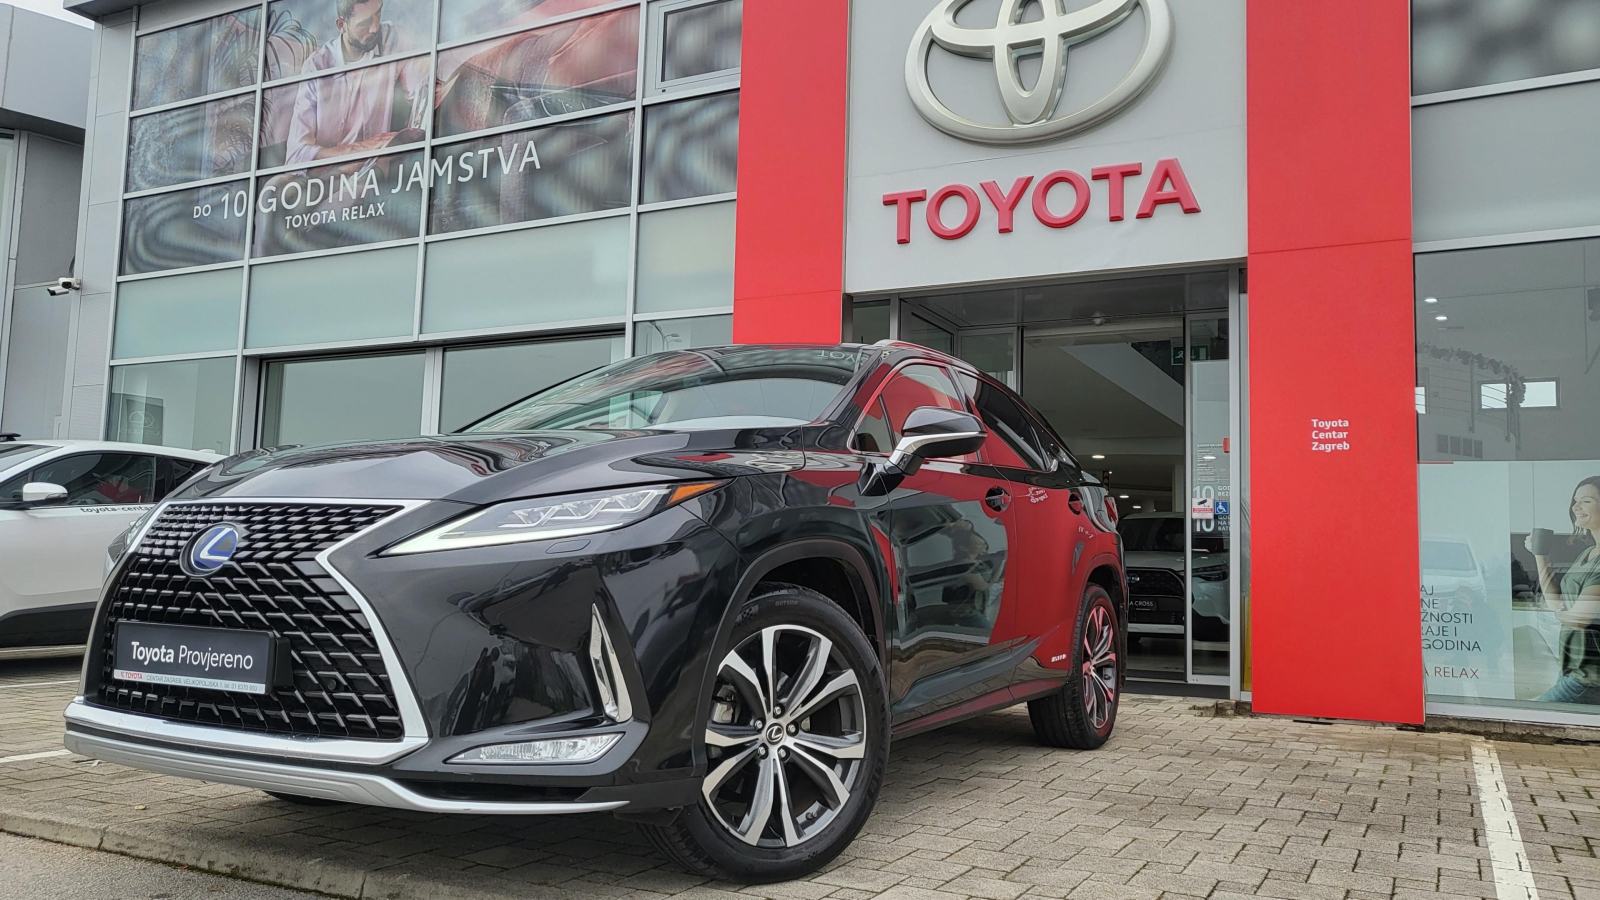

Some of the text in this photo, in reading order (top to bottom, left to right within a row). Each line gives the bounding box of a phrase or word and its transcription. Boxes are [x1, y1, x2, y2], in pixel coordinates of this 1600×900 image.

[193, 140, 541, 220] DO 10 GODINA JAMSTVA
[882, 157, 1202, 245] TOYOTA
[285, 202, 386, 229] TOYOTA RELAX
[1311, 418, 1349, 430] Toyota
[1311, 430, 1349, 440] Centar
[1311, 441, 1350, 453] Zagreb
[1422, 625, 1449, 637] AJE
[1422, 638, 1482, 651] GODINA
[131, 641, 254, 671] Toyota Provjereno
[1434, 666, 1480, 679] RELAX
